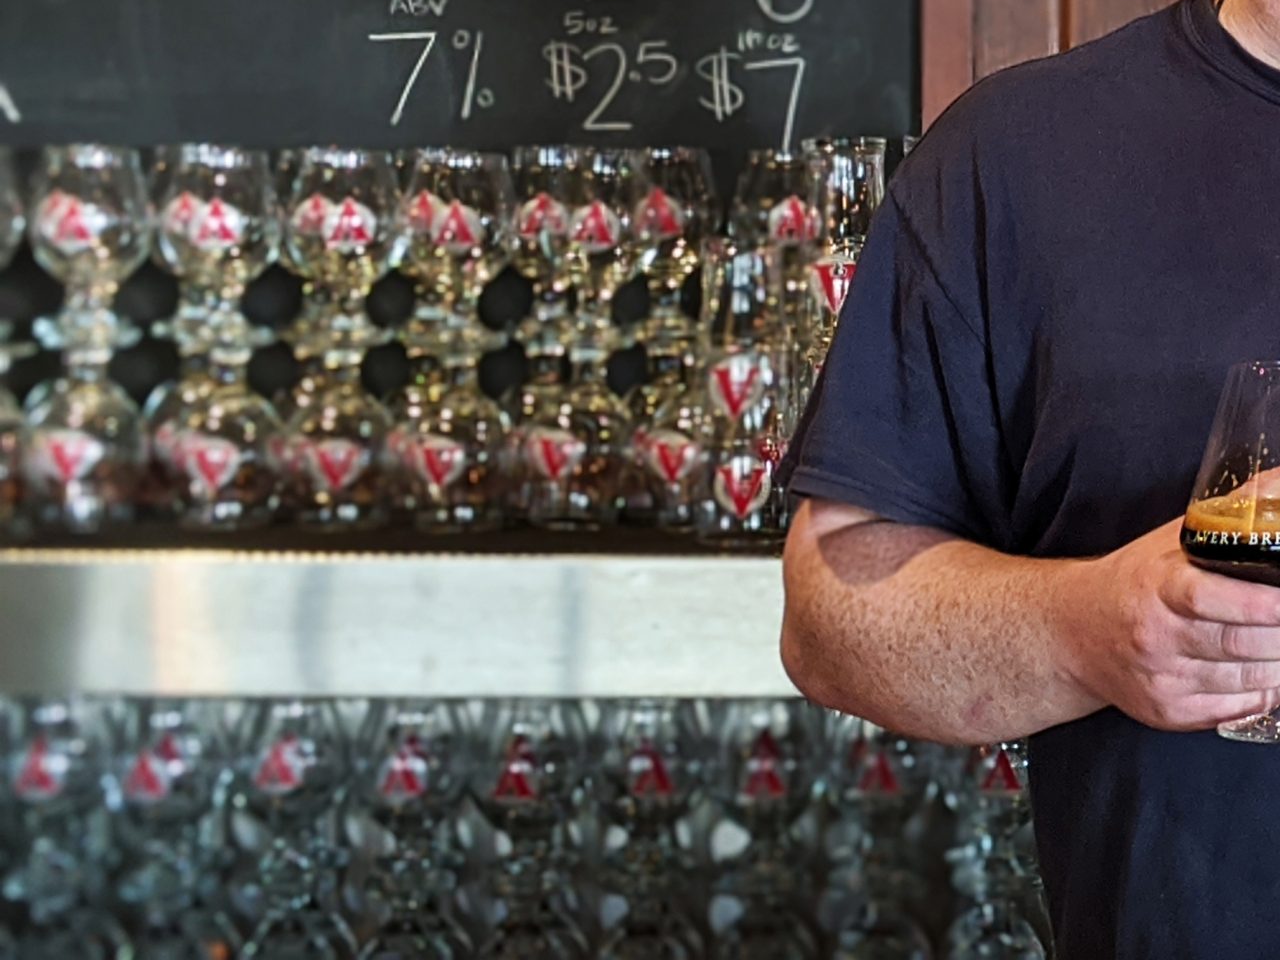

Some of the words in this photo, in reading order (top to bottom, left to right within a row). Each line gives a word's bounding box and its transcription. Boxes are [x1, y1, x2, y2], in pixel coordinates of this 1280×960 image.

[368, 30, 494, 126] 7%
[542, 40, 678, 131] $2.5
[696, 44, 806, 152] $7
